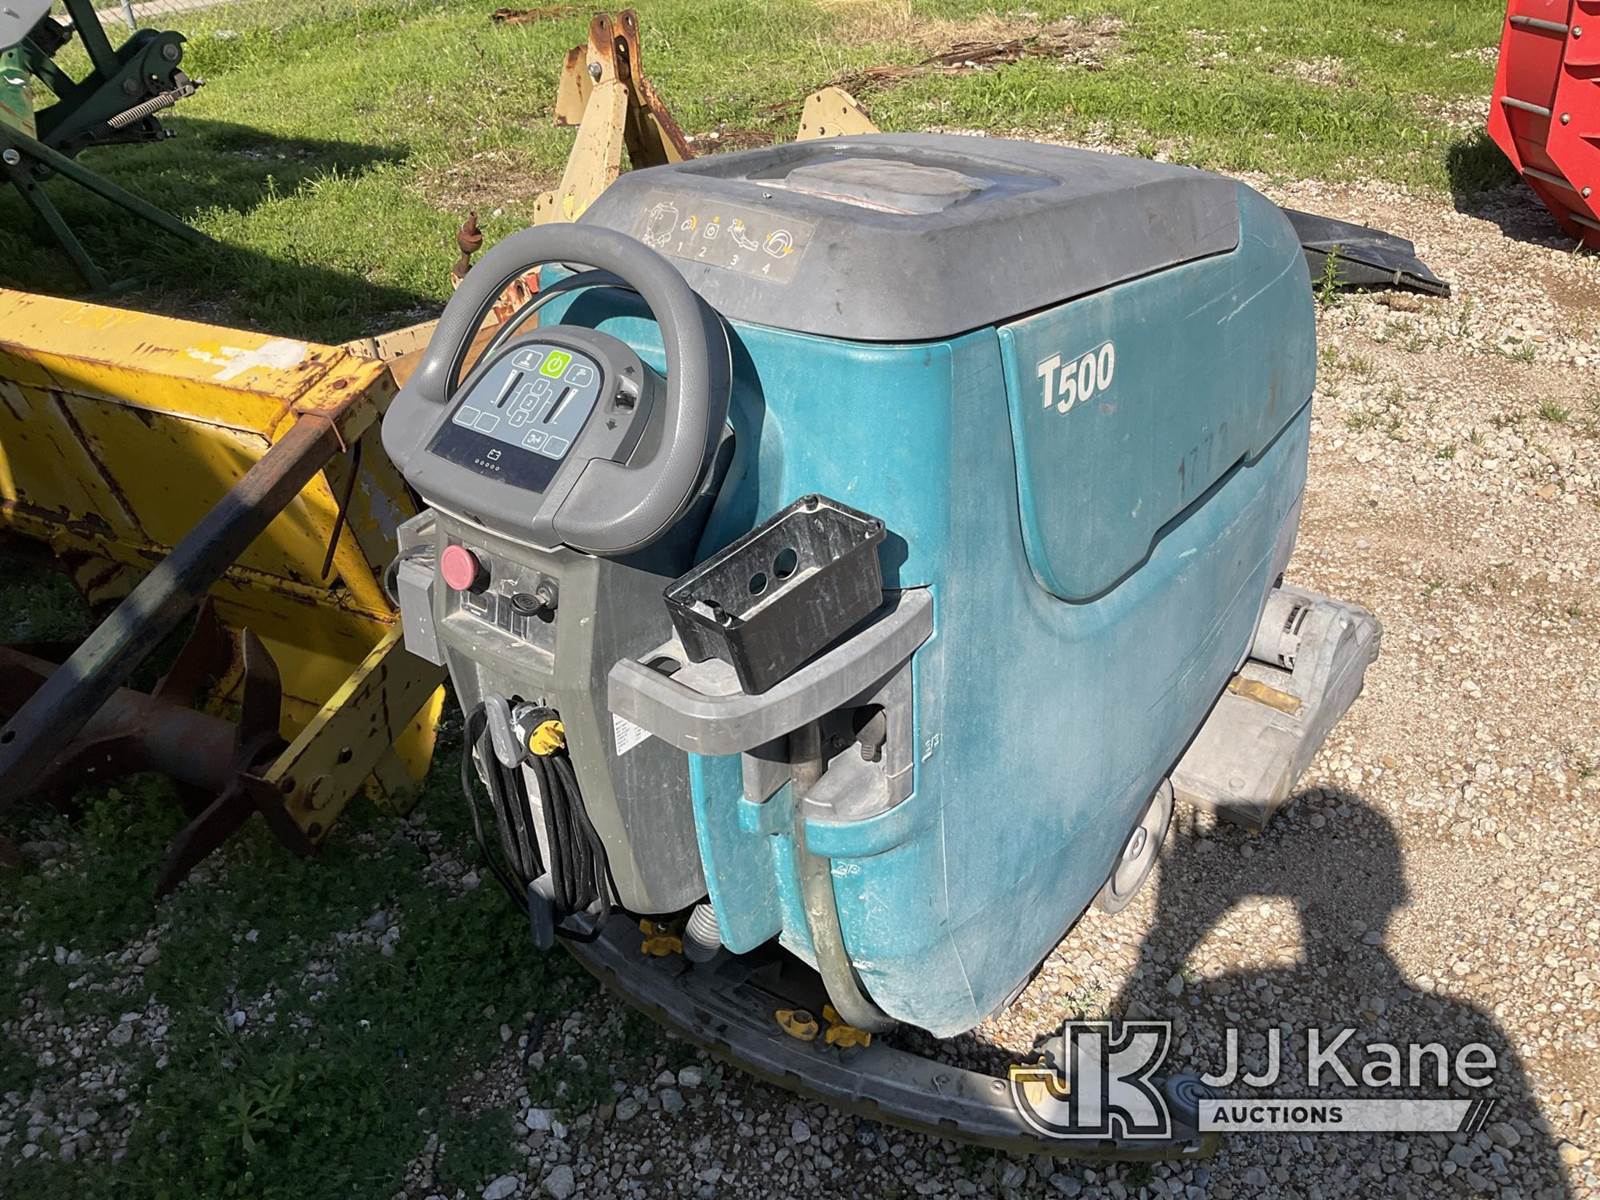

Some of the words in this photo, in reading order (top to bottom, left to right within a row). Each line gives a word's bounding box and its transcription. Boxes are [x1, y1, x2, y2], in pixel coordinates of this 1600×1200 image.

[698, 247, 707, 257] 2
[730, 254, 739, 265] 3
[761, 262, 770, 274] 4
[1037, 342, 1115, 414] T500
